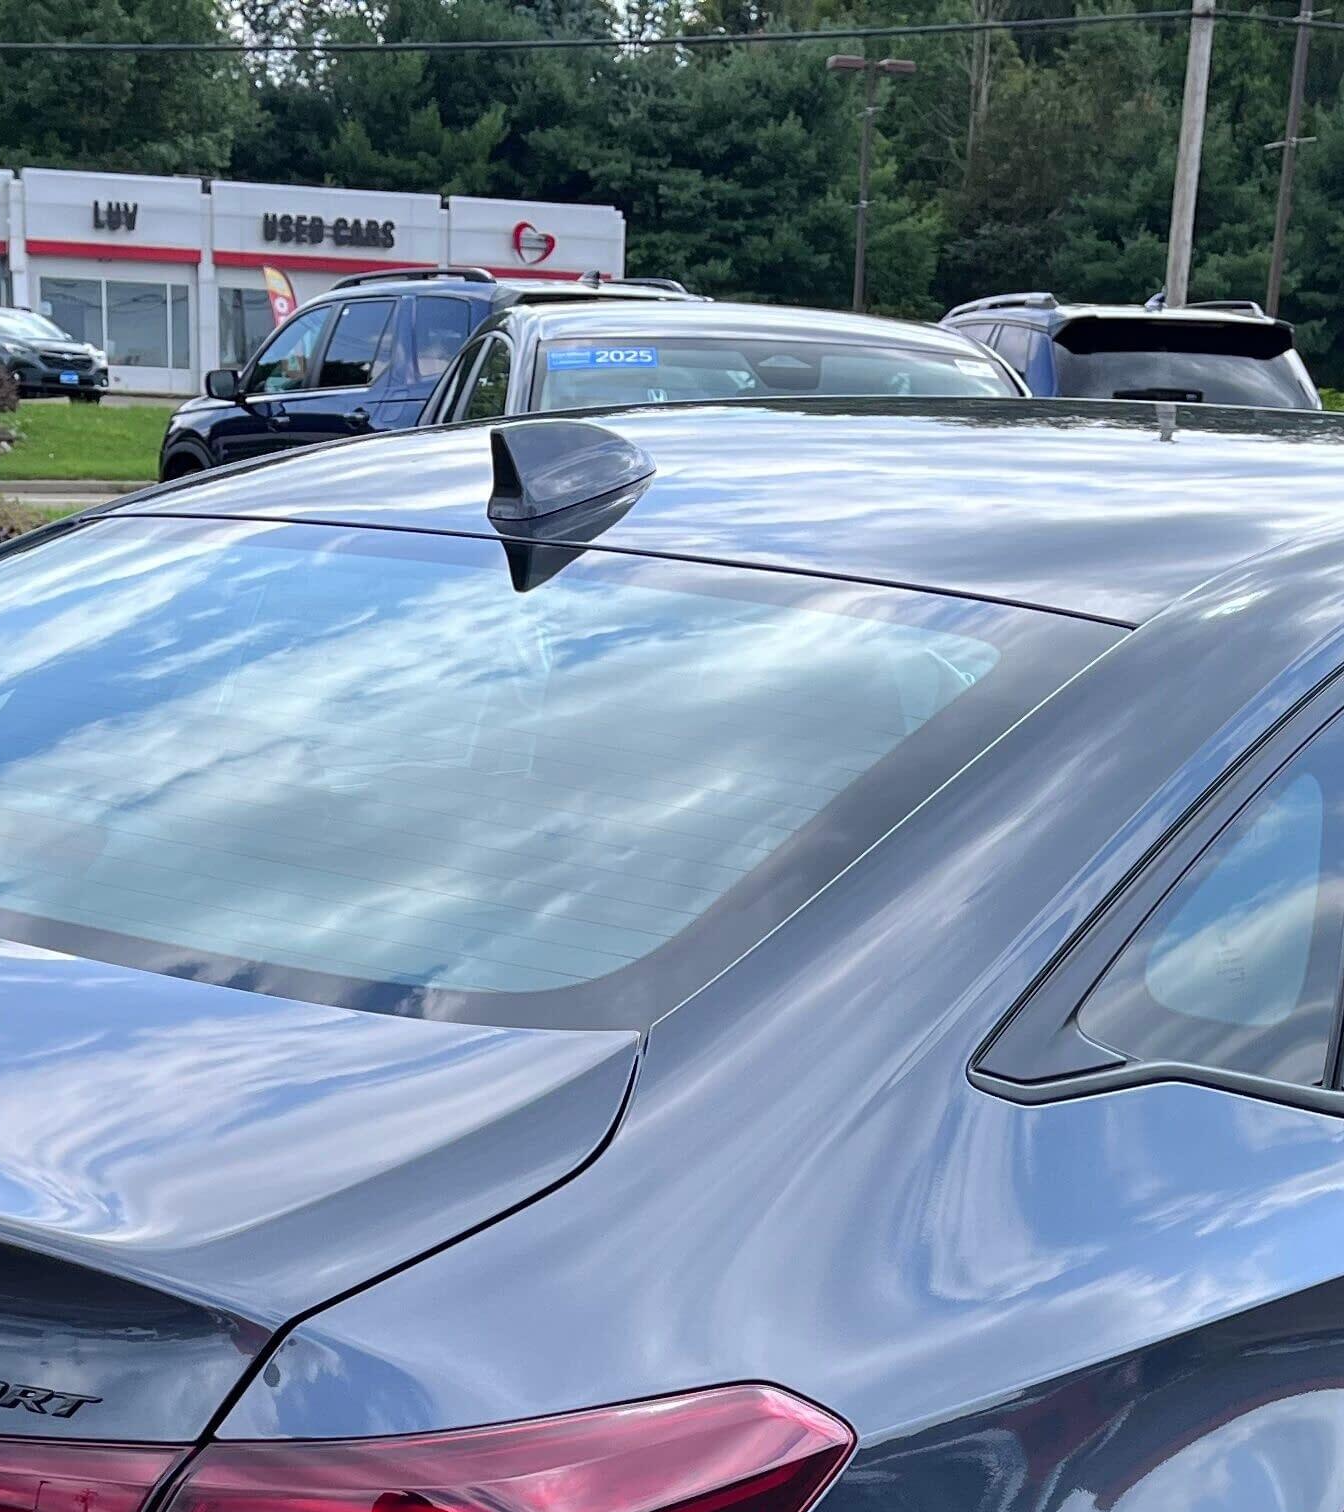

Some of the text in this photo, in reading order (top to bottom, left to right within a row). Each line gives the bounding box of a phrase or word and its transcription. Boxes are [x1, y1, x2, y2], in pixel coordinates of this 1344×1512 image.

[93, 200, 137, 231] LUV
[263, 213, 395, 249] USED CARS
[595, 350, 653, 363] 2025
